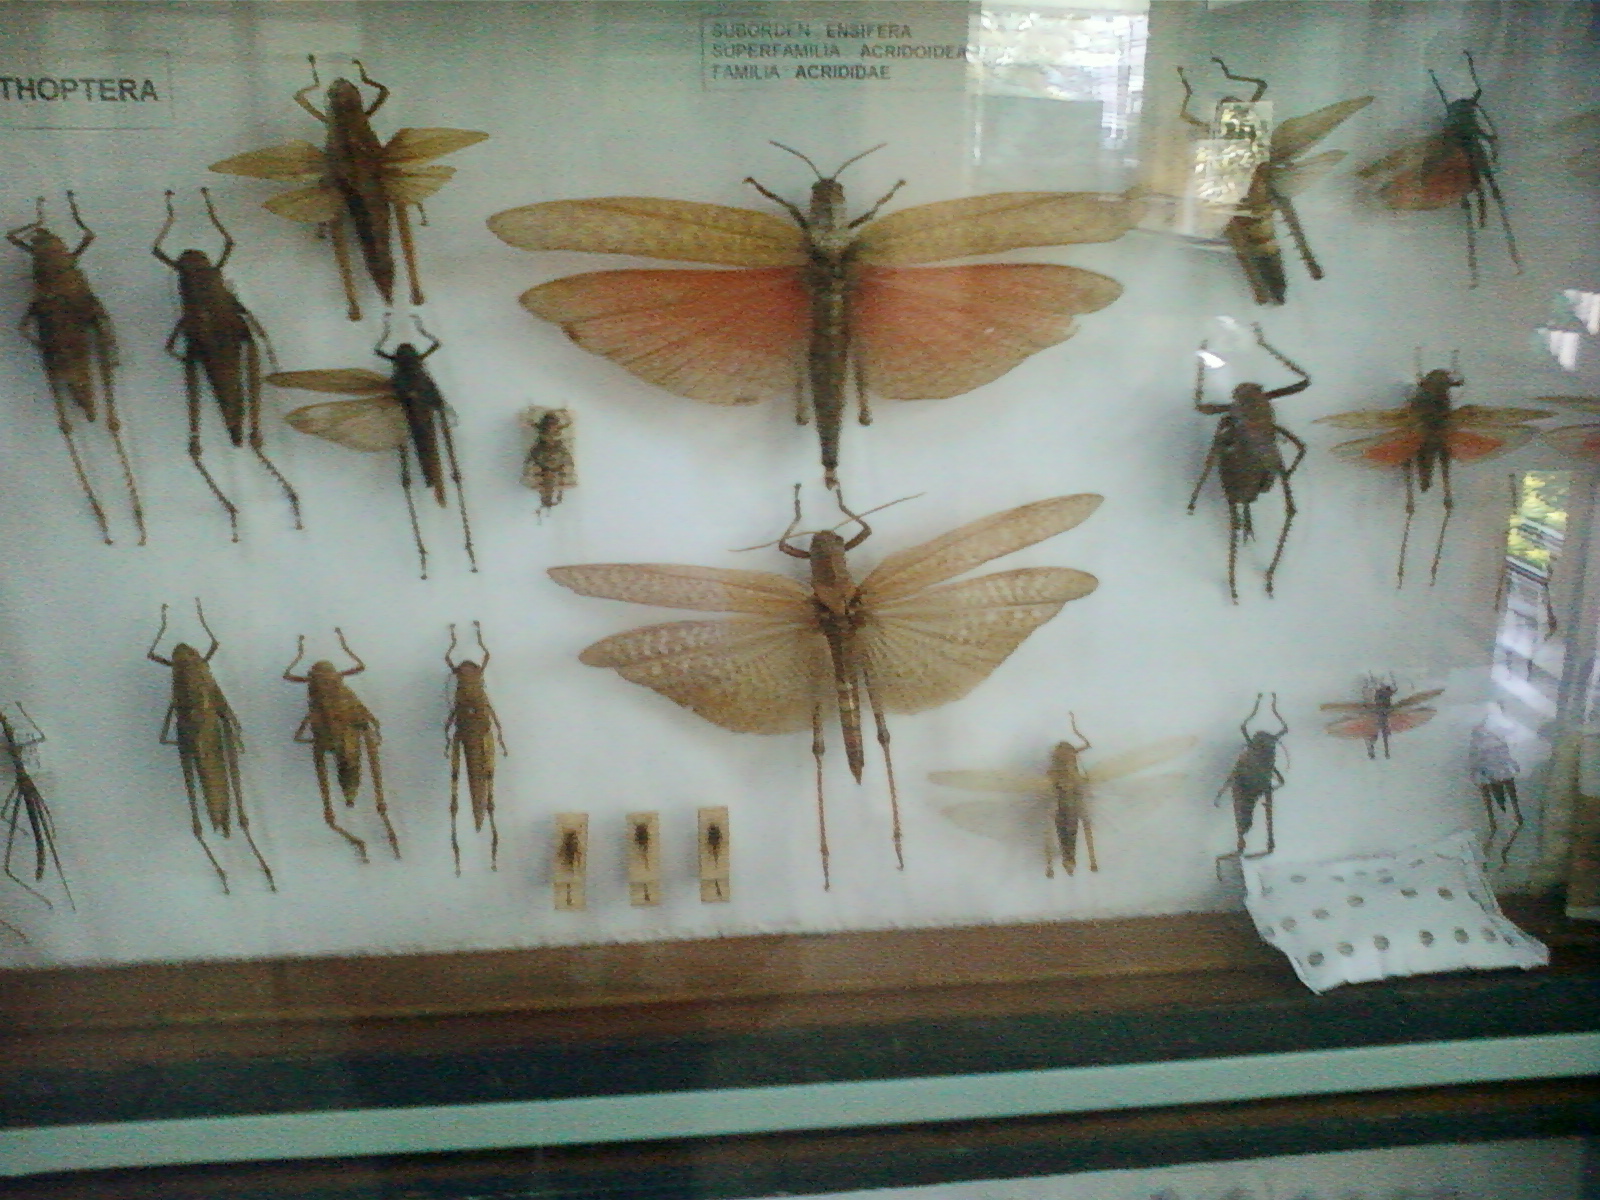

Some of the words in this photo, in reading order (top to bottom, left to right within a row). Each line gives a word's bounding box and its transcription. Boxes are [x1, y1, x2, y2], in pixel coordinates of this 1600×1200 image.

[826, 22, 912, 38] ENSIFERA
[712, 43, 840, 58] SUPERFAMILIA
[860, 43, 967, 59] ACRIDOIDEA
[712, 64, 780, 79] FAMILIA
[795, 64, 890, 79] ACRIDIDAE
[0, 77, 158, 101] THOPTERA
